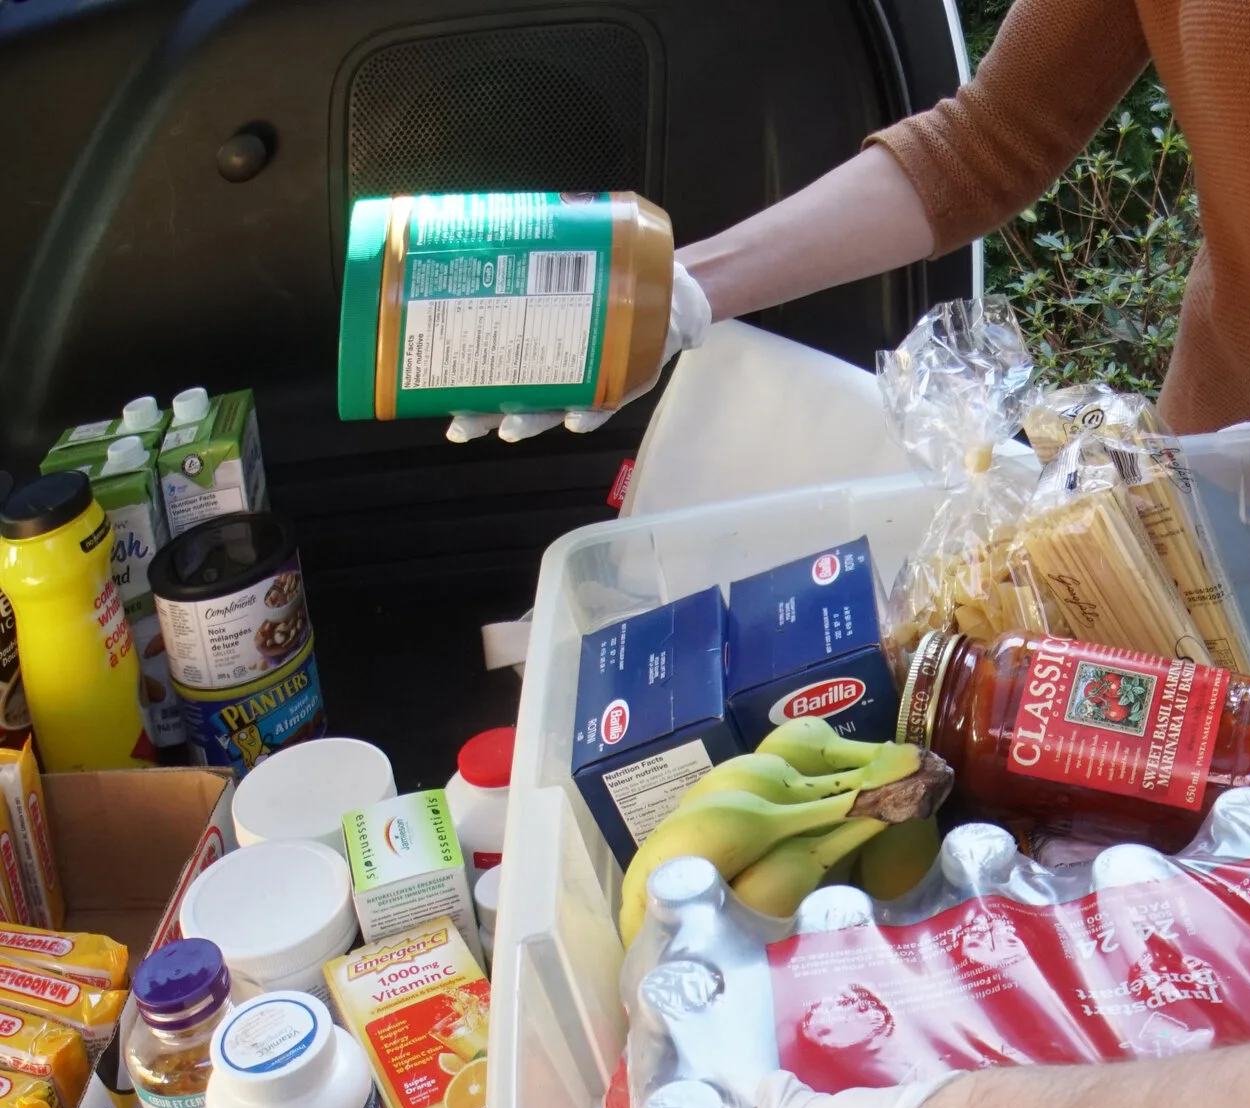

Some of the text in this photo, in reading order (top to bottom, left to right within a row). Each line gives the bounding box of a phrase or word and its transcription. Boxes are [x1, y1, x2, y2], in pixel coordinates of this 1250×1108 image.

[404, 335, 415, 388] Nutrition Facts
[413, 333, 424, 387] Valeur nutritive
[208, 627, 226, 636] Noix
[209, 627, 252, 644] mélangées
[212, 640, 240, 652] de luxe
[220, 670, 309, 731] PLANTERS
[792, 682, 857, 717] Barilla
[1209, 689, 1219, 711] SAUCE
[587, 718, 597, 744] ROTINI
[609, 709, 623, 739] Barilla
[1203, 714, 1213, 741] SAUCE
[1142, 704, 1174, 790] SWEET BASIL
[1157, 693, 1188, 788] MARINARA AU
[1196, 740, 1207, 767] PASTA
[605, 755, 664, 782] Nutrition Facts
[608, 762, 669, 789] Valeur nutritive
[1191, 771, 1201, 786] mL
[1186, 784, 1197, 804] 650
[1134, 918, 1180, 942] 24
[353, 933, 443, 974] Emergen-C
[1075, 927, 1121, 961] 24
[372, 964, 457, 1003] Vitamin C
[377, 961, 440, 987] 1,000 mg
[1081, 982, 1224, 1017] Jumpstart
[383, 1034, 409, 1049] Energy
[391, 1051, 411, 1063] More
[393, 1054, 421, 1069] Vitamin
[427, 1045, 444, 1055] than
[403, 1075, 428, 1089] Super
[405, 1078, 436, 1095] Orange
